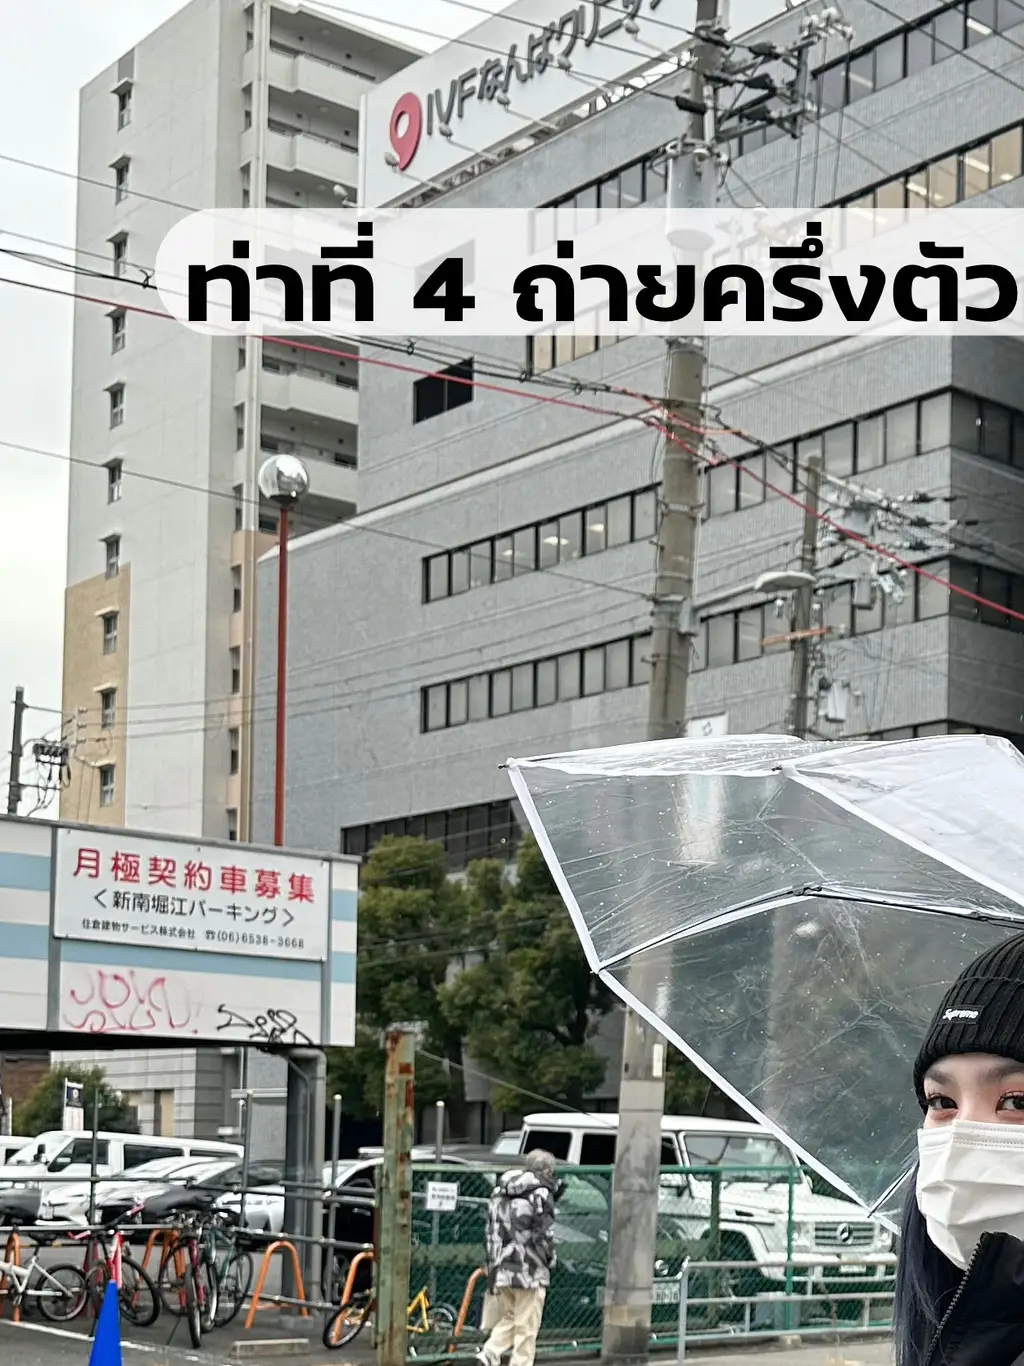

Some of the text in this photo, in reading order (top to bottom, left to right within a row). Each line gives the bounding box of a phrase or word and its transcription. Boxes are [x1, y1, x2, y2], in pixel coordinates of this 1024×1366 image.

[73, 848, 316, 904] 月極契約車募集
